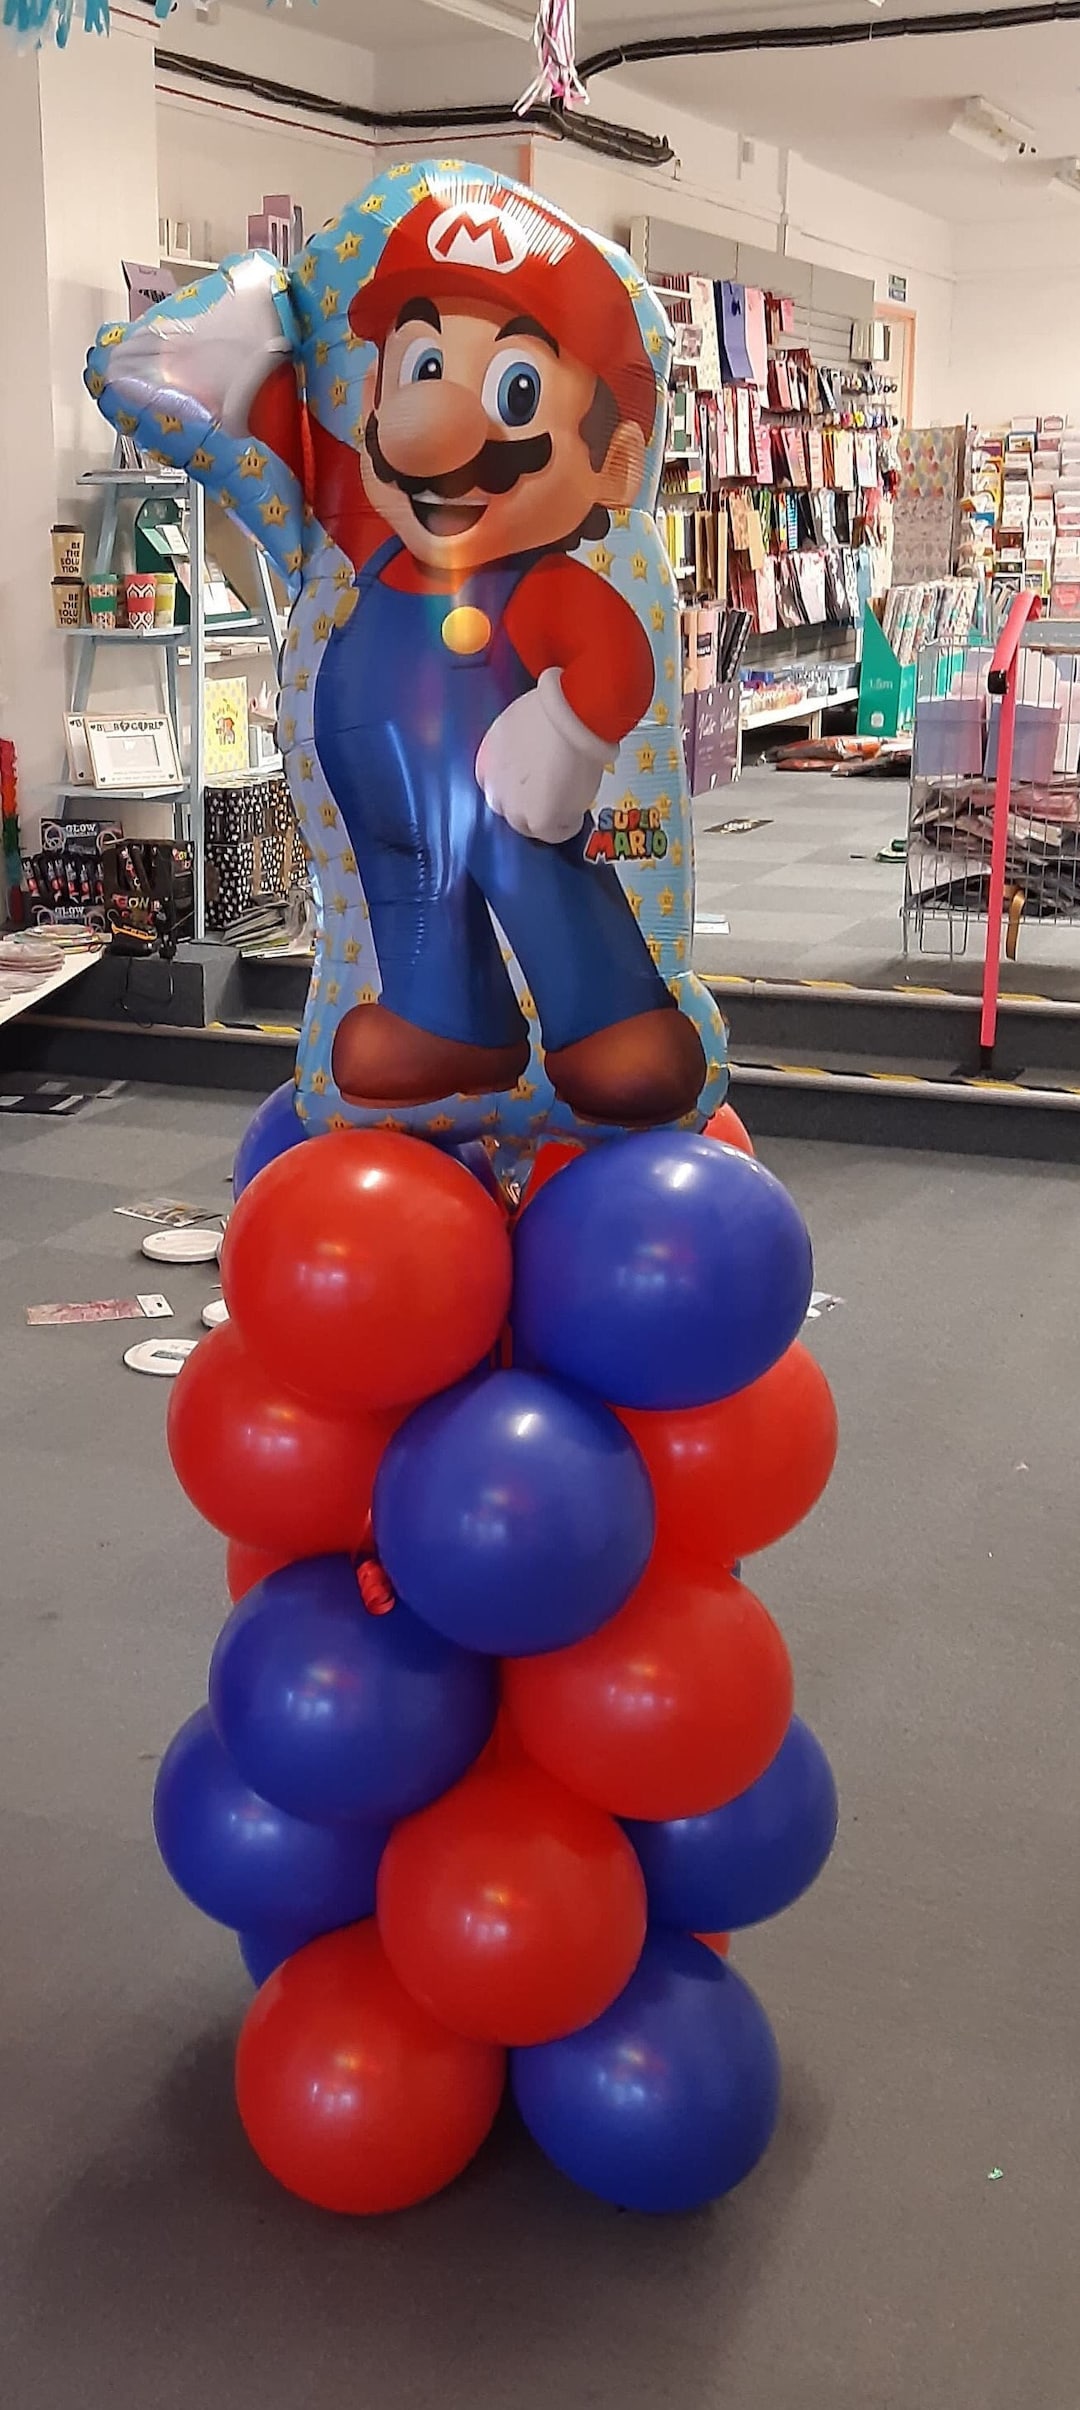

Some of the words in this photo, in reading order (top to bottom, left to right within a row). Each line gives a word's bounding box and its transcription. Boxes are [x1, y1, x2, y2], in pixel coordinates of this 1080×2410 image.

[434, 211, 514, 265] M
[66, 550, 80, 558] THE
[599, 808, 660, 830] SUPER
[66, 824, 96, 833] GLOW
[586, 829, 668, 860] MARIO
[55, 906, 85, 915] GLOW
